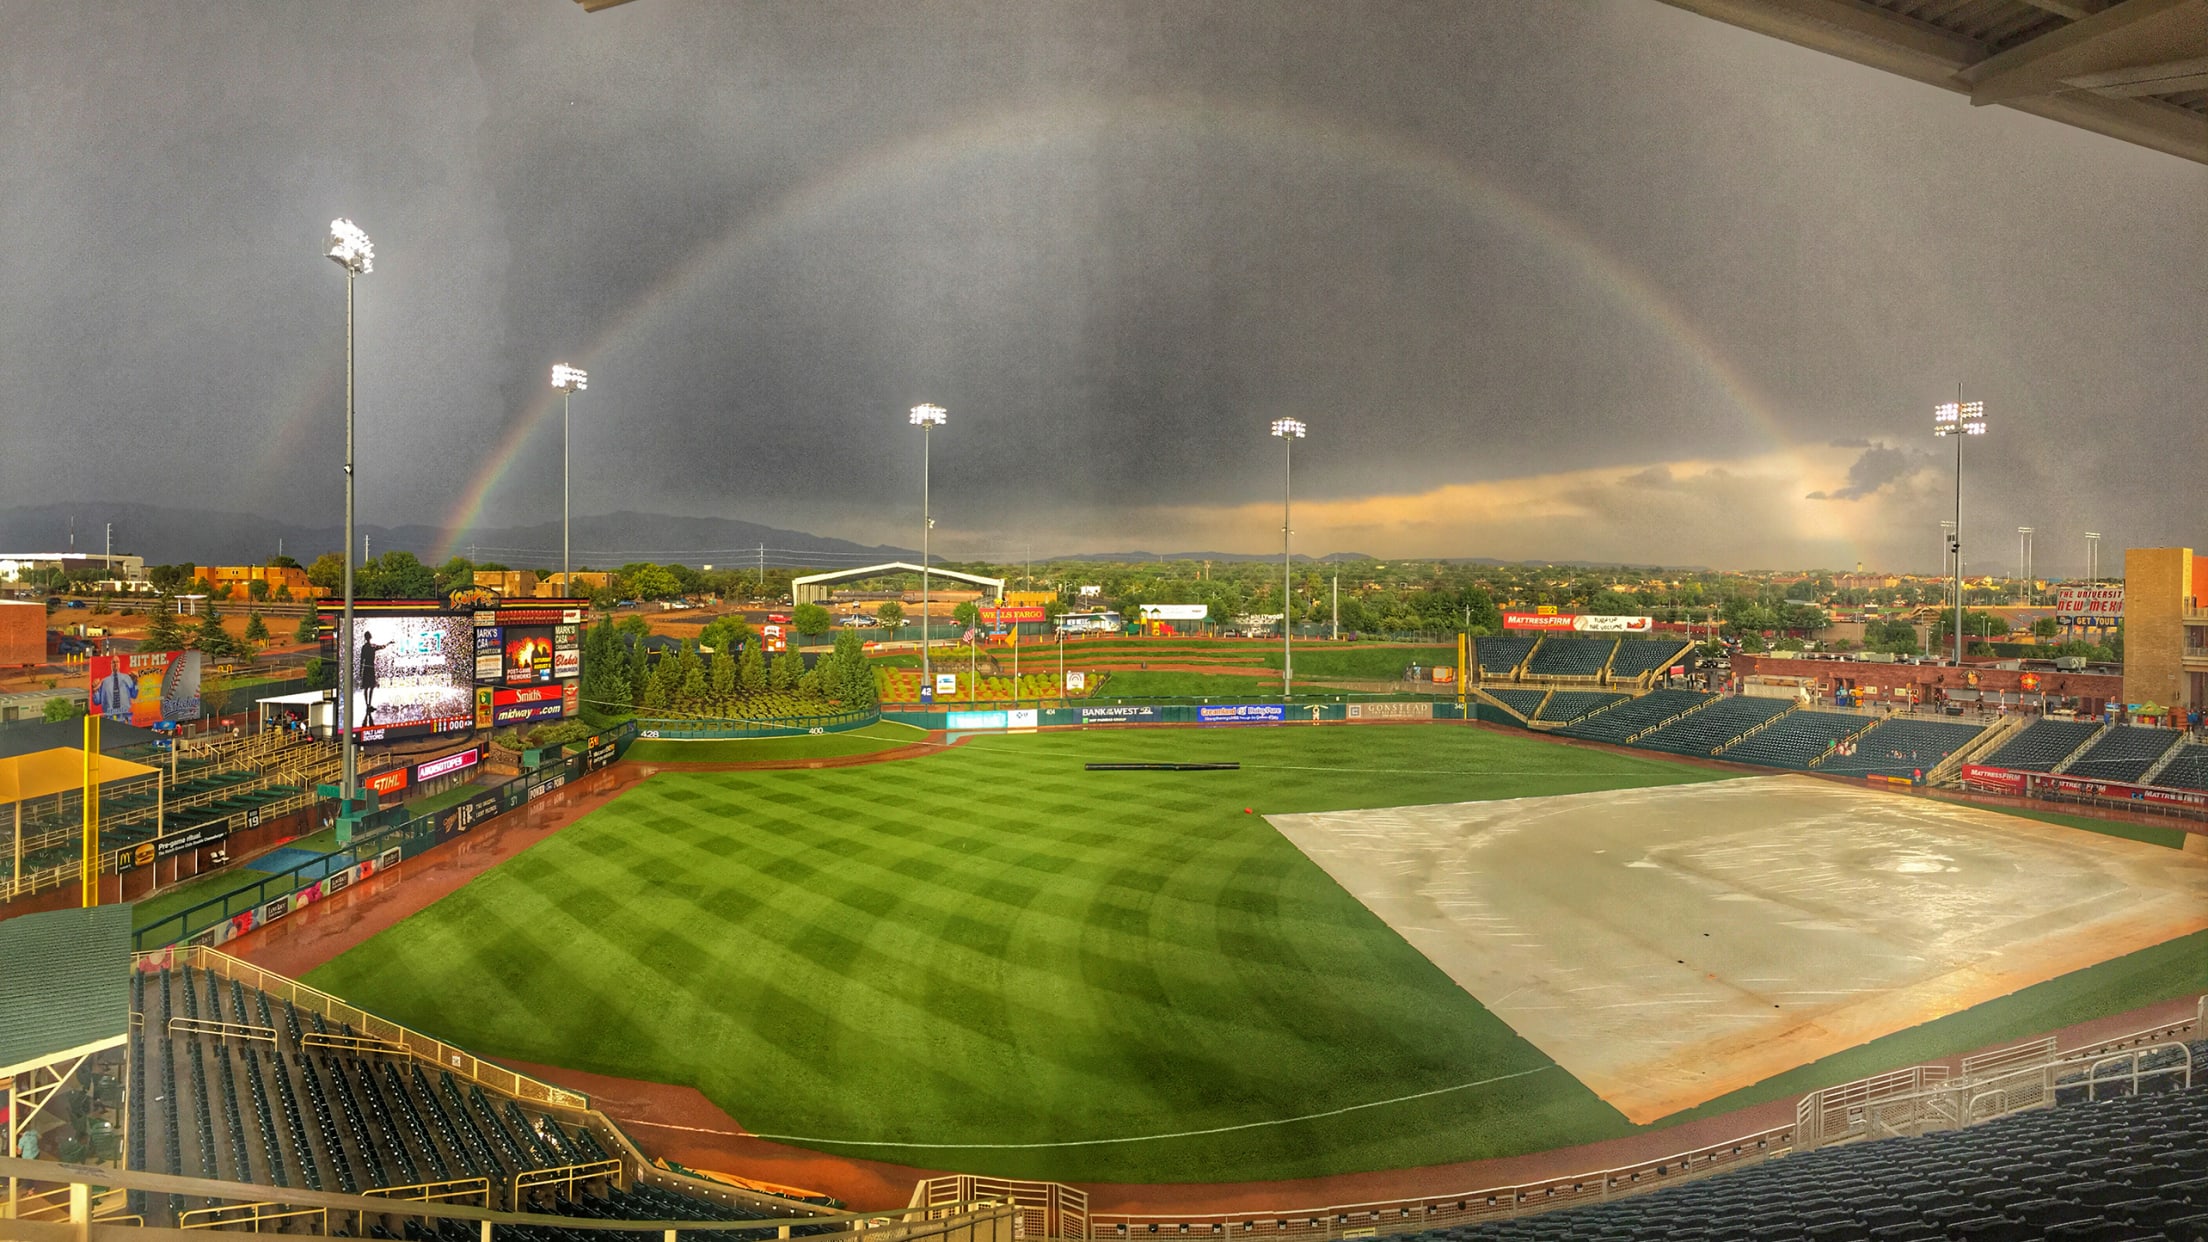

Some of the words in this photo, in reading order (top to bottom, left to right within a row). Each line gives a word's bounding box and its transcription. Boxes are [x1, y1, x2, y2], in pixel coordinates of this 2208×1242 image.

[2077, 590, 2122, 598] UNIVERSIT
[2058, 601, 2083, 611] NEW
[2090, 601, 2122, 611] MEXI
[982, 611, 1012, 619] WELS
[1014, 610, 1042, 618] FARGO
[2077, 617, 2091, 625] GET
[2095, 617, 2114, 625] YOUR
[129, 655, 150, 668] HIT
[516, 689, 541, 703] Smith's
[921, 688, 932, 696] 42
[1082, 709, 1106, 717] BANK
[640, 730, 660, 738] 428
[809, 727, 824, 735] 400
[374, 773, 400, 791] STIHL
[248, 816, 259, 828] 19
